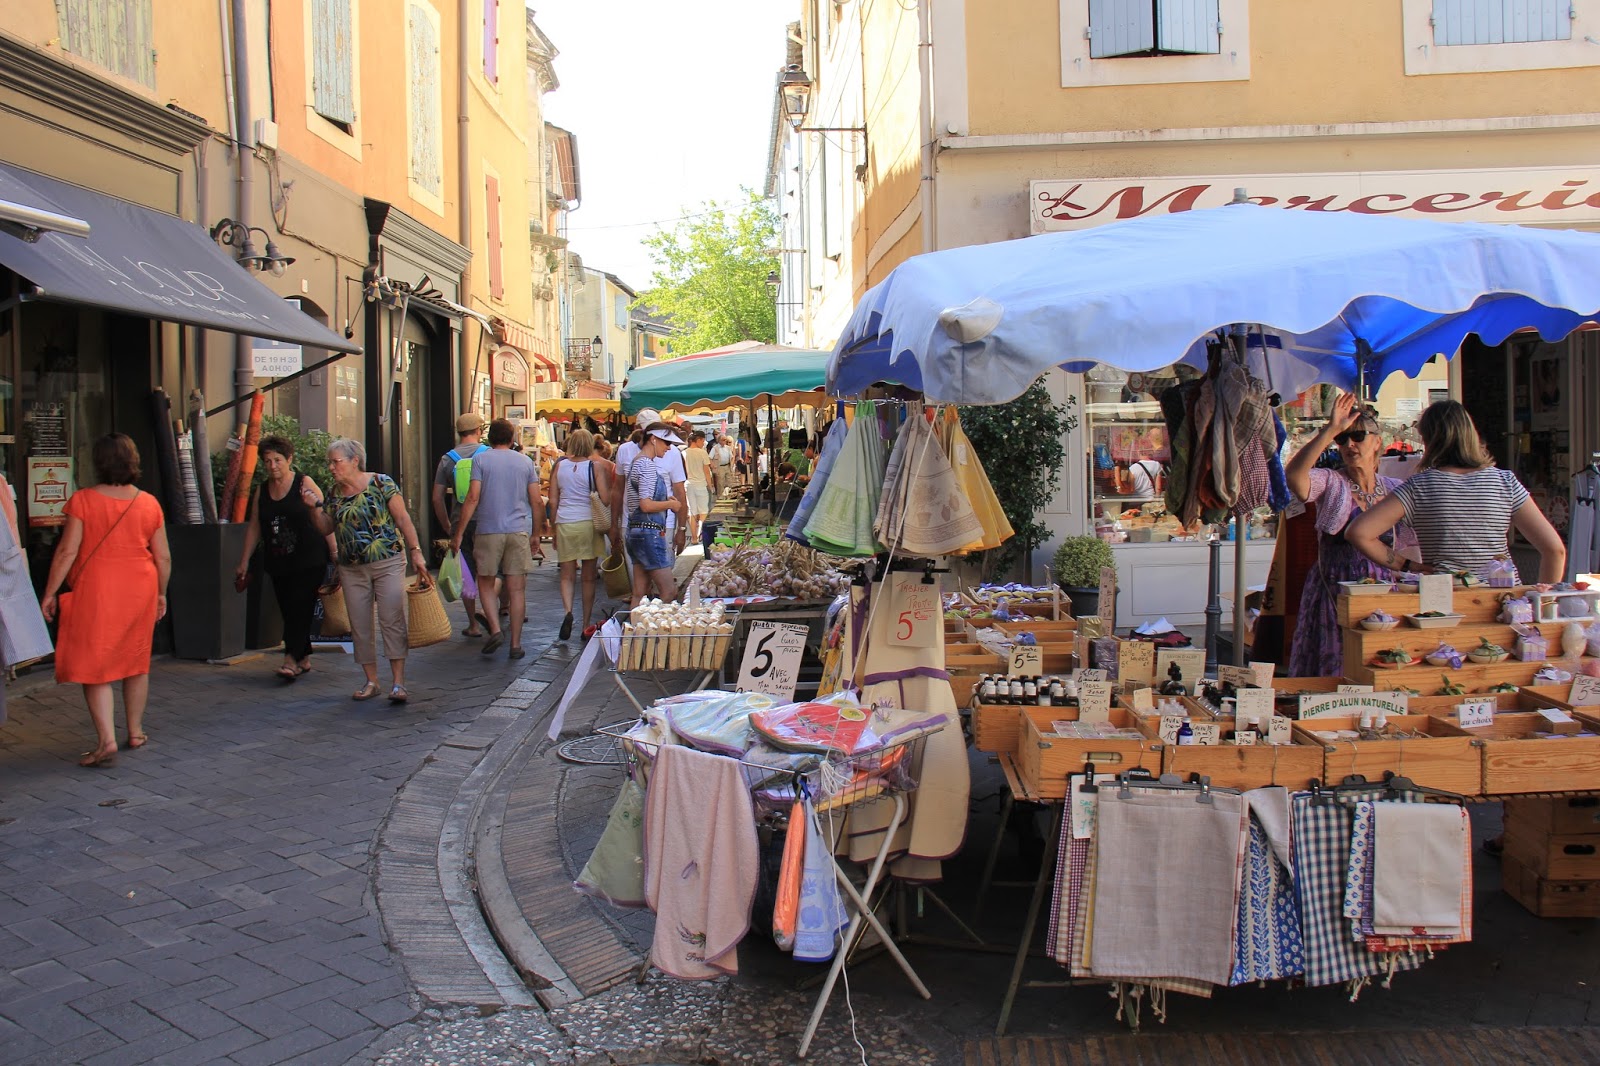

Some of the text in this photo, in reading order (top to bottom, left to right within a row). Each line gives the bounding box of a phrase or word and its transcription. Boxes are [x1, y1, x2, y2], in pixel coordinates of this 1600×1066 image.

[1052, 180, 1600, 220] Mrceri
[122, 255, 247, 303] JOUR
[897, 611, 913, 640] 5
[750, 630, 776, 677] 5
[1014, 654, 1025, 669] 5
[769, 666, 787, 680] AVEC
[1303, 698, 1405, 719] PIERRE D'ALUN NATURELLE
[1468, 706, 1475, 716] 5
[1472, 716, 1492, 725] choix
